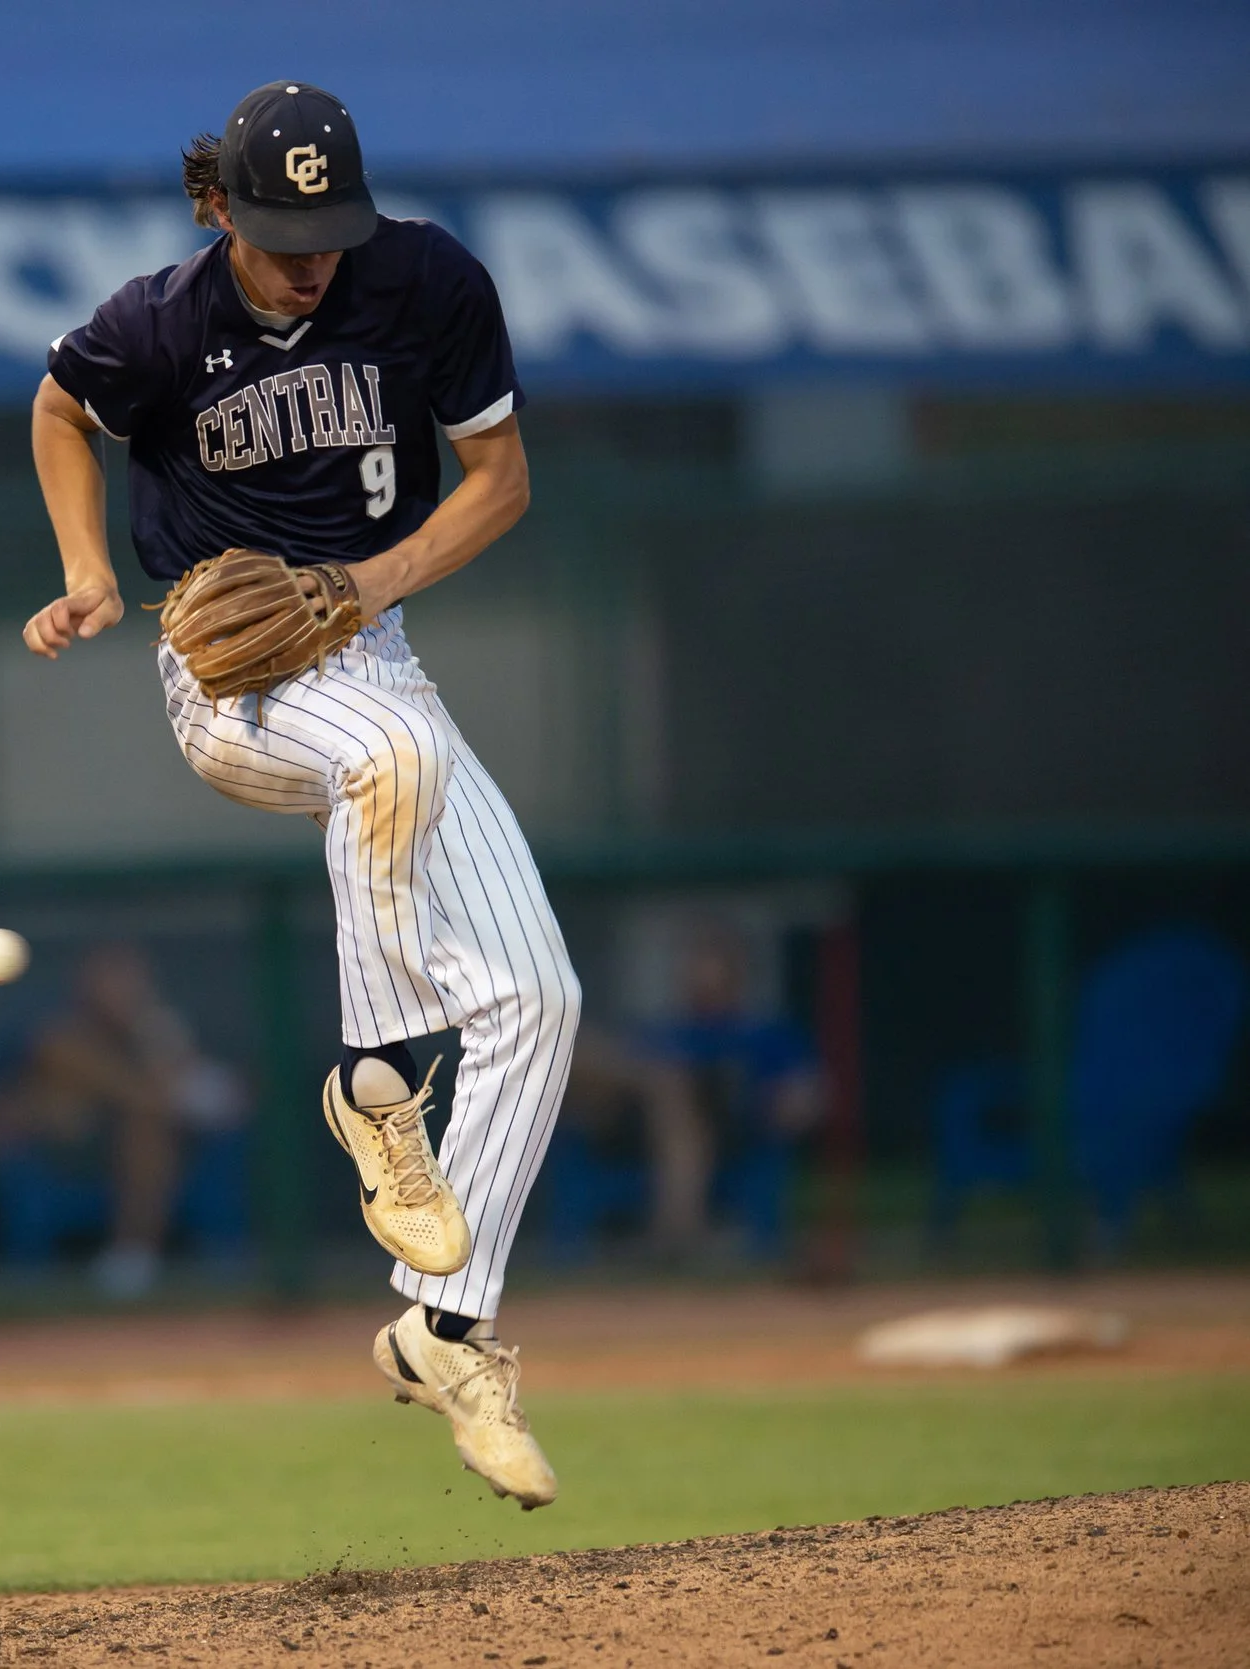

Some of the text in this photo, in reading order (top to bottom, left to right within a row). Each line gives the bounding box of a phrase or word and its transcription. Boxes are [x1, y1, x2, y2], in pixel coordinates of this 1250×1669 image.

[286, 143, 329, 194] CC
[400, 182, 1250, 360] ASEBA
[196, 363, 396, 471] CENTRAL
[358, 444, 397, 520] 9
